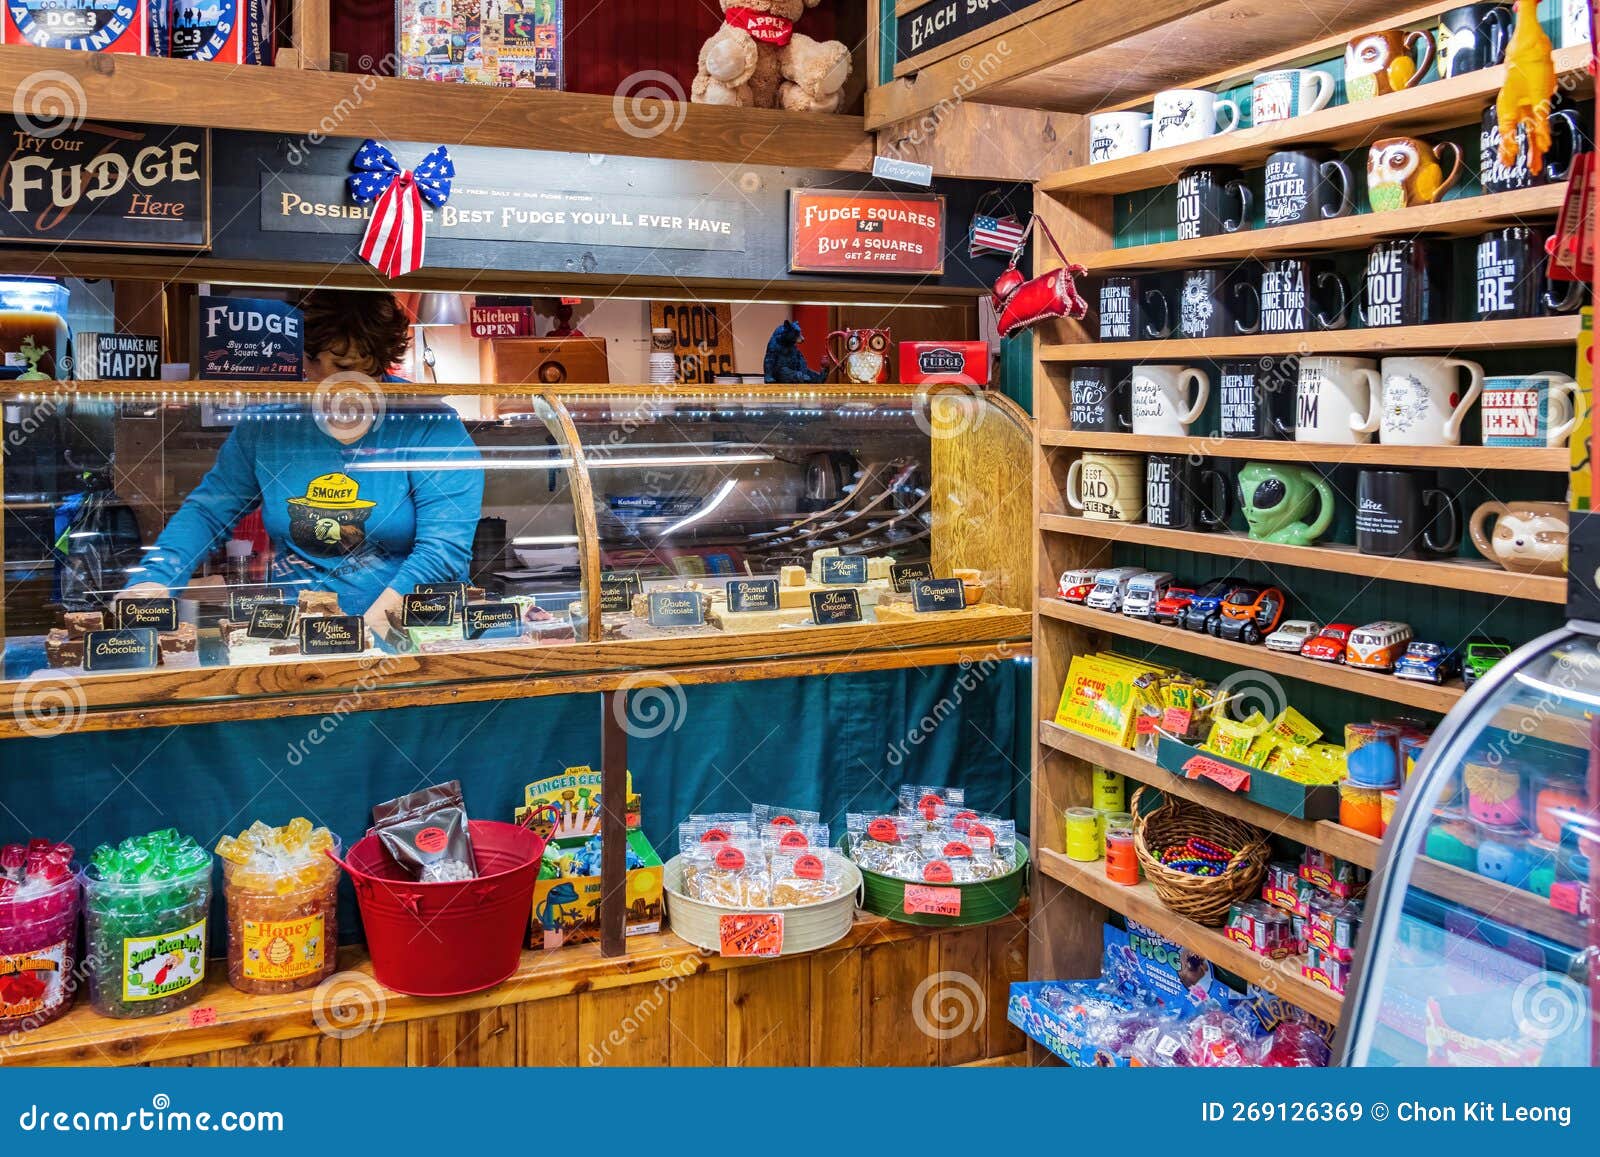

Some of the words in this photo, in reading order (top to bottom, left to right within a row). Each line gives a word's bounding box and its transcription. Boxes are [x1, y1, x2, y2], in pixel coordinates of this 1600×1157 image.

[11, 6, 51, 48] AIR
[47, 12, 97, 26] DC-3
[747, 16, 785, 30] APPLE
[151, 10, 165, 59] VERSEAS
[911, 4, 957, 51] EACH
[173, 29, 202, 43] C-3
[250, 24, 264, 66] VERSEAS
[13, 131, 46, 152] Try
[9, 142, 200, 212] FUDGE
[1177, 175, 1200, 198] OVE
[1266, 179, 1305, 200] ETTER
[128, 194, 185, 216] Here
[1177, 196, 1200, 223] OU
[280, 192, 371, 219] POSSIBL
[440, 205, 494, 226] BEST
[501, 207, 565, 227] FUDGE
[637, 214, 683, 230] EVER
[687, 217, 731, 235] HAVE
[804, 205, 861, 227] FUDGE
[867, 208, 936, 229] SQUARES
[1177, 221, 1200, 240] ORE
[818, 237, 848, 254] BUY
[852, 238, 861, 249] 4
[864, 240, 923, 255] SQUARES
[844, 252, 862, 260] GET
[864, 251, 872, 260] 2
[874, 253, 897, 261] FREE
[1368, 249, 1402, 276] LOVE
[1262, 270, 1292, 293] ERE'S
[1295, 270, 1305, 292] A
[1368, 273, 1402, 306] YOU
[1283, 292, 1305, 309] THIS
[1477, 275, 1515, 314] ERE
[1107, 297, 1130, 312] UNTIL
[205, 305, 299, 339] FUDGE
[472, 309, 520, 323] Kitchen
[1265, 309, 1304, 331] VODKA
[476, 324, 516, 335] OPEN
[99, 336, 117, 351] YOU
[119, 338, 145, 352] MAKE
[147, 340, 158, 352] ME
[226, 340, 242, 351] Buy
[233, 348, 258, 358] Square
[99, 353, 157, 378] HAPPY
[223, 360, 229, 371] 4
[270, 361, 278, 372] 2
[923, 357, 962, 367] FUDGE
[1228, 387, 1255, 404] UNTIL
[1234, 418, 1256, 432] WINE
[1085, 469, 1102, 480] BEST
[1149, 462, 1170, 483] OVE
[311, 486, 353, 499] SMOKEY
[1082, 480, 1108, 498] DAD
[1148, 483, 1170, 508] OU
[1084, 502, 1104, 513] EVER
[1148, 508, 1170, 526] ORE
[600, 588, 621, 596] ouble
[126, 604, 170, 615] Chocolate
[411, 600, 446, 612] Pistachio
[659, 597, 691, 608] Double
[136, 614, 160, 622] Pecan
[471, 610, 513, 622] Amaretto
[658, 607, 694, 615] Chocolate
[313, 620, 345, 633] White
[473, 621, 511, 630] Chocolate
[108, 637, 137, 646] Classic
[325, 631, 351, 640] Sands
[96, 643, 146, 656] Chocolate
[1077, 676, 1106, 691] CACTUS
[529, 775, 577, 798] FINGER
[258, 922, 312, 938] Honey
[129, 947, 156, 970] Sour
[147, 976, 191, 995] Bombs
